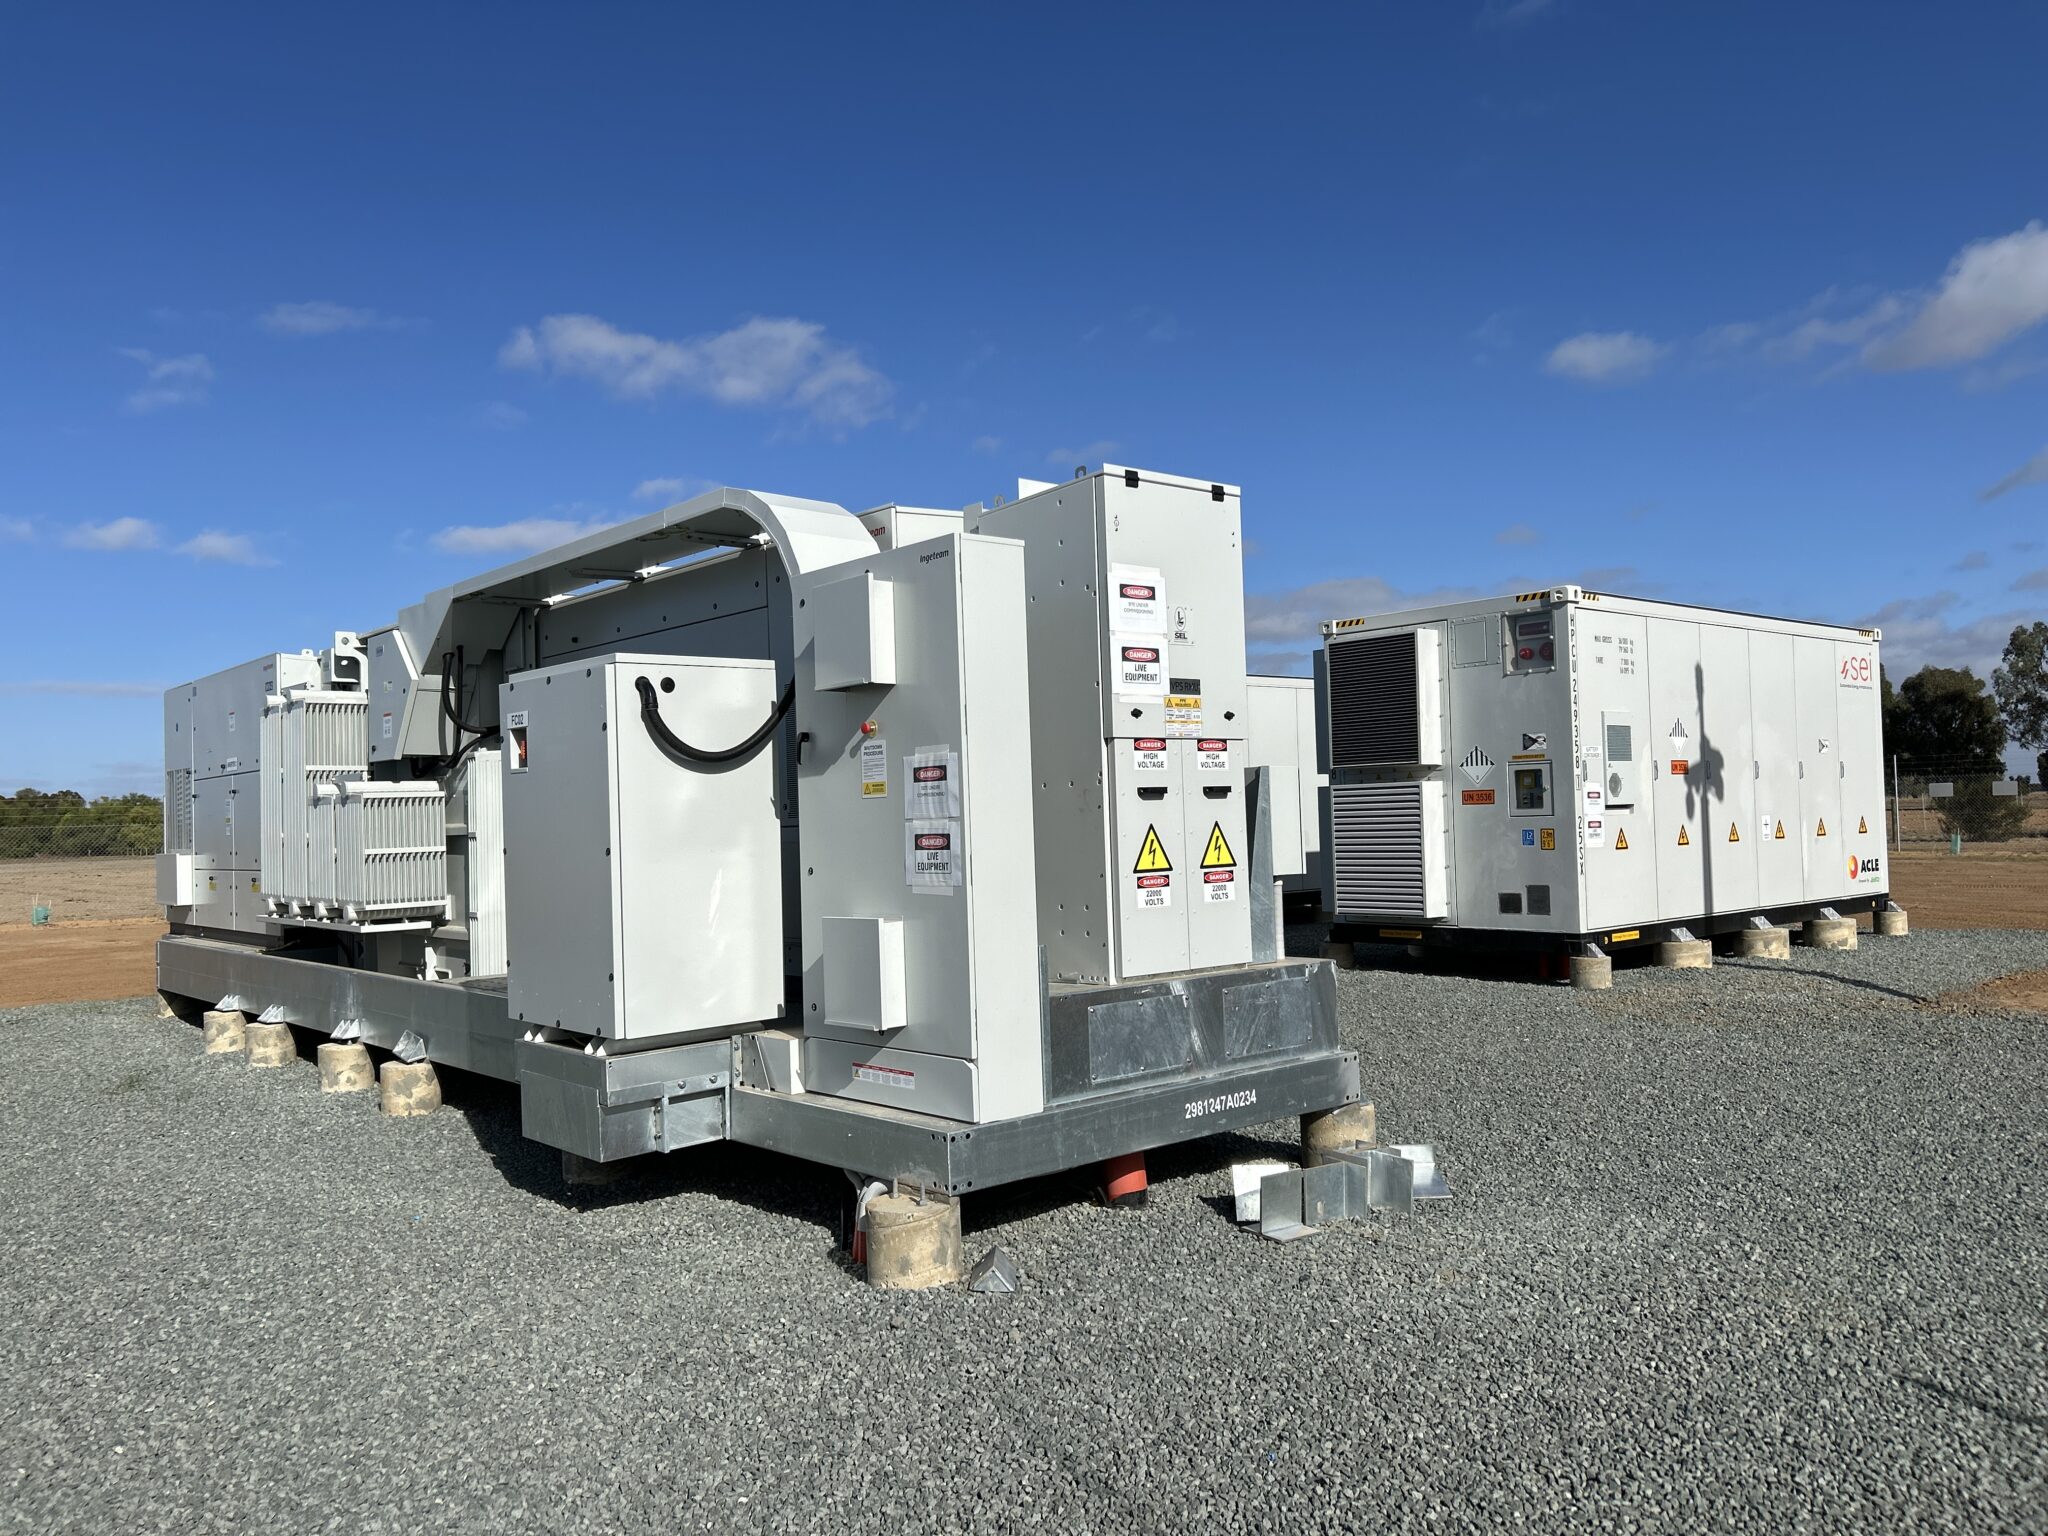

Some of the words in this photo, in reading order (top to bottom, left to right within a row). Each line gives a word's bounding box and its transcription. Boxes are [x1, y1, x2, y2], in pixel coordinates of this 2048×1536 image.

[920, 549, 949, 564] Ingeteam
[1127, 588, 1149, 596] DANGER
[1174, 632, 1188, 640] SEL
[1130, 651, 1152, 659] DANGER
[1135, 664, 1147, 672] LIVE
[1125, 673, 1158, 682] EQUIPMENT
[512, 714, 523, 726] FC02
[1138, 761, 1164, 769] VOLTAGE
[920, 770, 940, 778] DANGER
[1463, 793, 1474, 802] UN
[1476, 793, 1492, 801] 3536
[927, 852, 939, 860] LIVE
[917, 862, 949, 871] EQUIPMENT
[1861, 858, 1879, 873] ACLE
[1212, 884, 1227, 892] 22000
[1145, 898, 1164, 906] VOLTS
[1185, 1088, 1257, 1119] 2981247A0234
